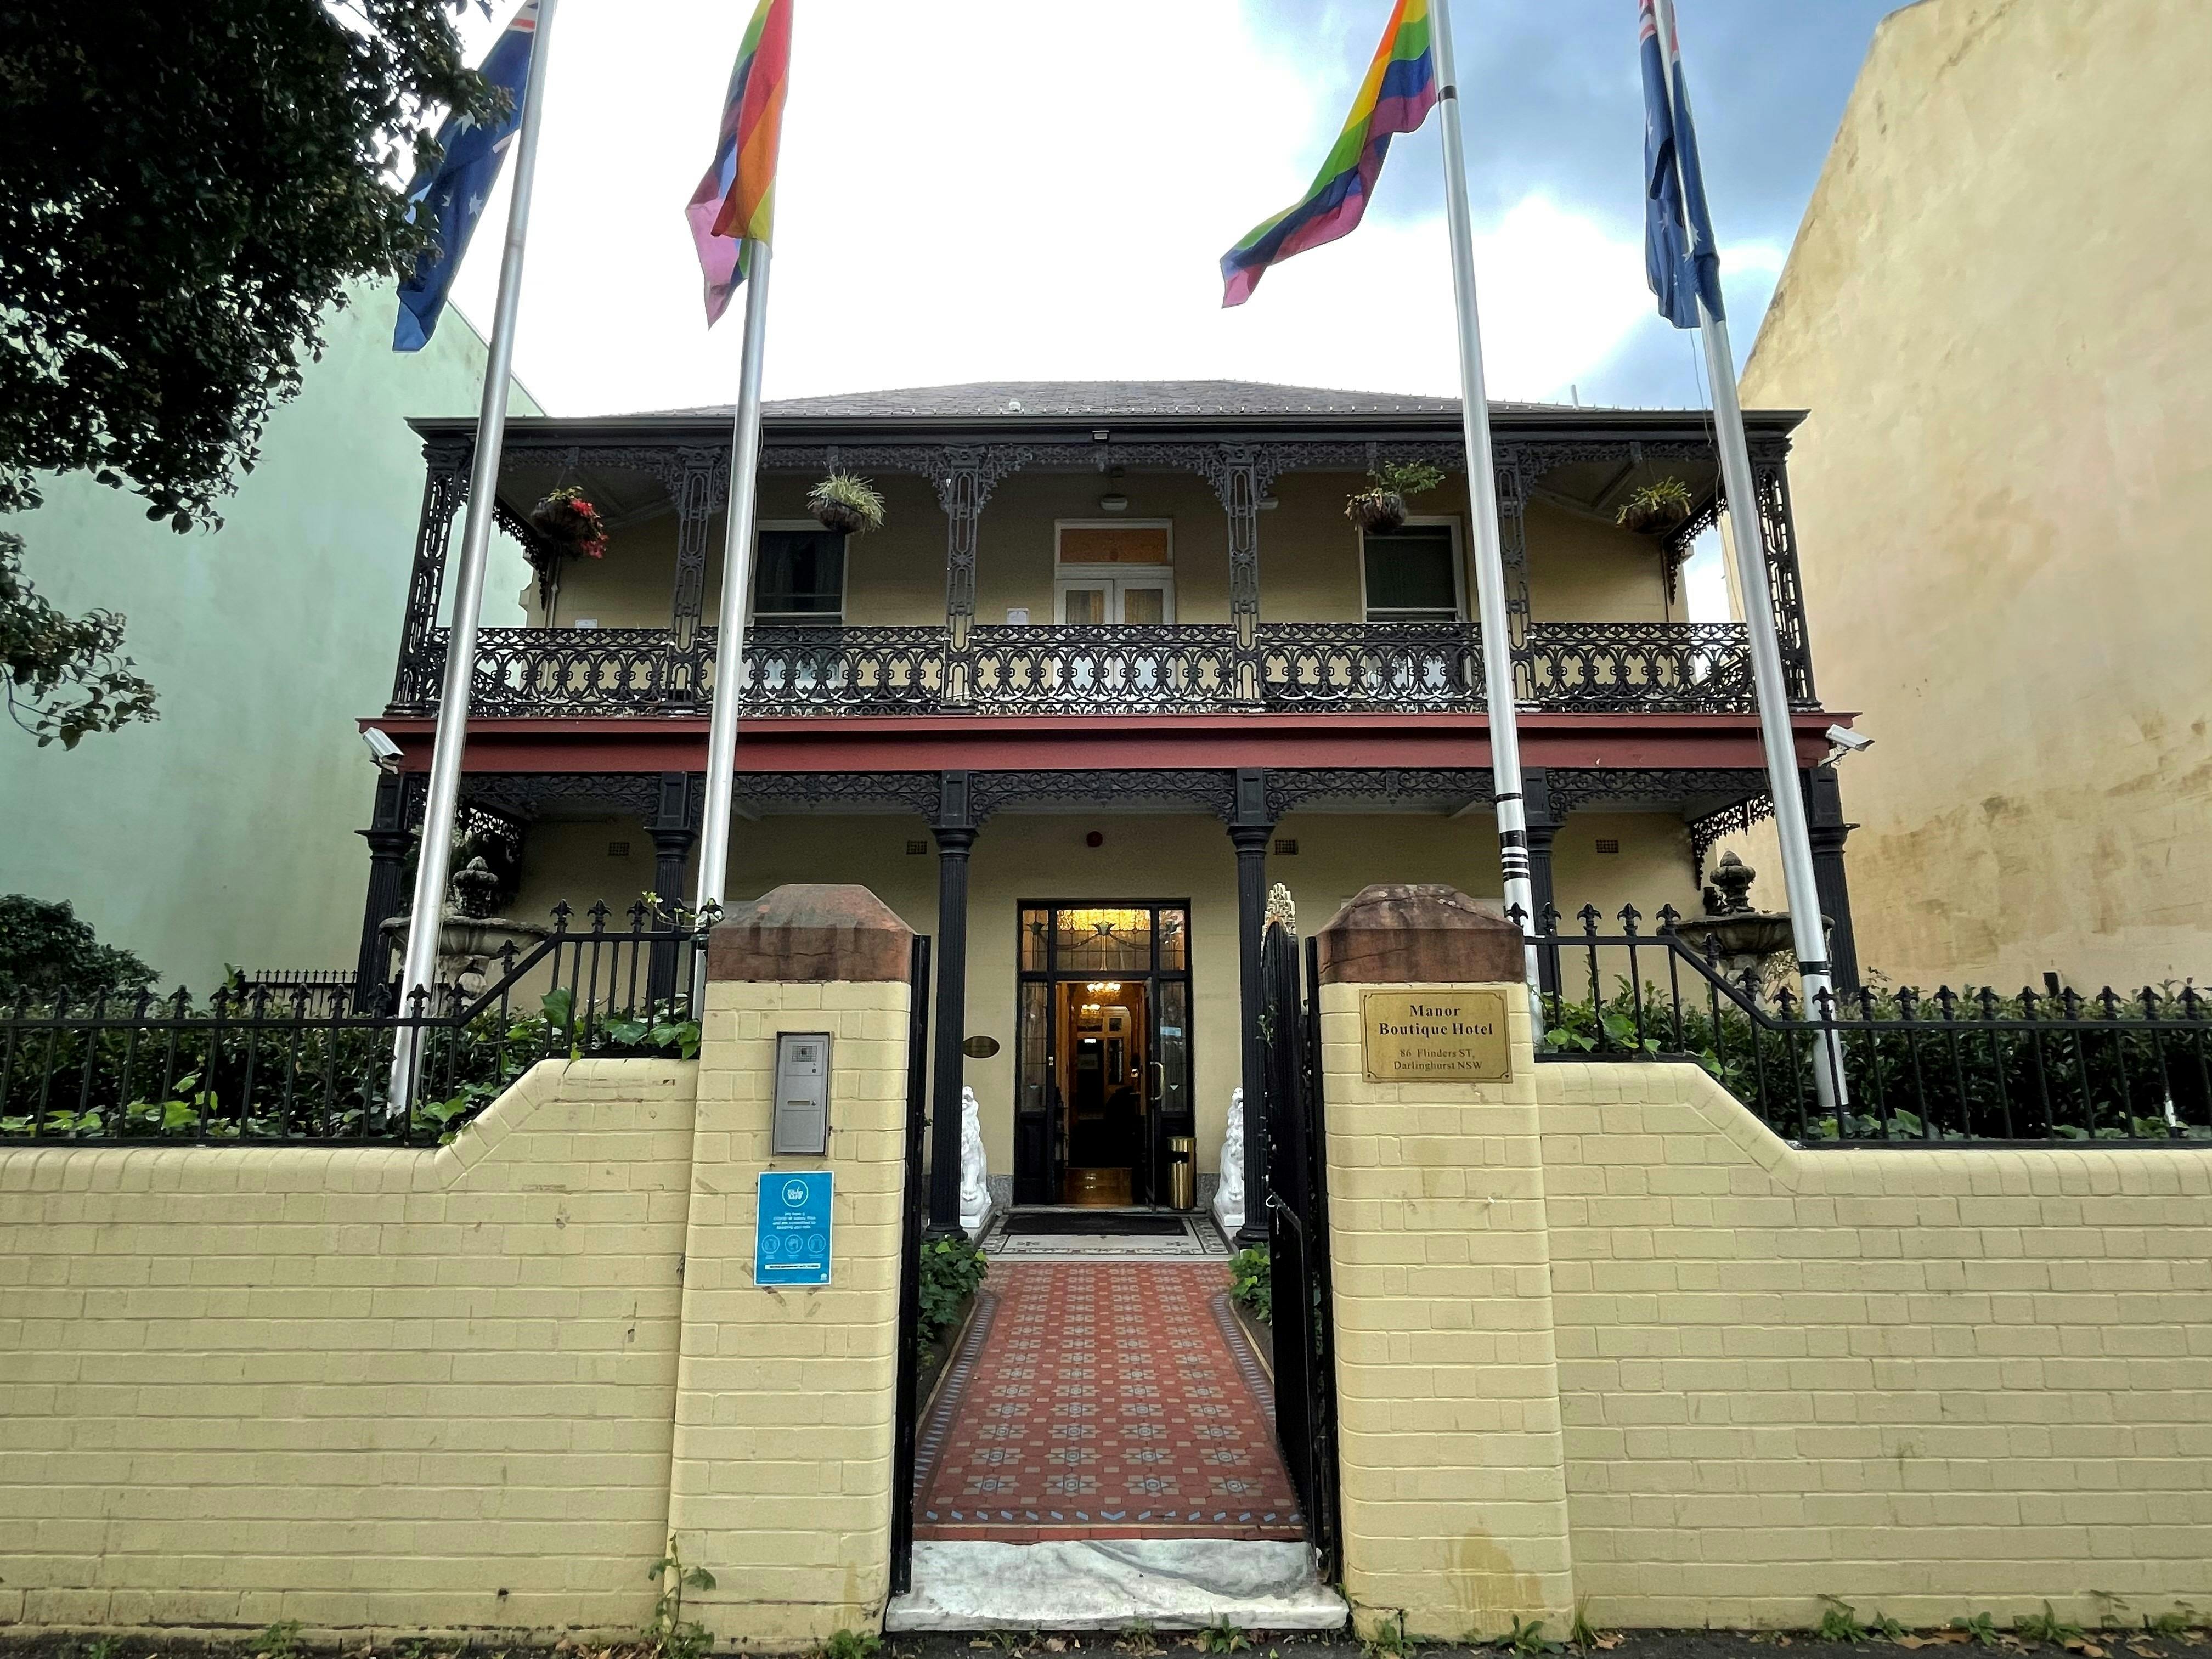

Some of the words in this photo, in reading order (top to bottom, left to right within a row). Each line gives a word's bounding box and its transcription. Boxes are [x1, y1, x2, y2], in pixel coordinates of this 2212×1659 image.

[1410, 1005, 1461, 1017] Manor
[1379, 1023, 1448, 1038] Boutique
[1453, 1023, 1493, 1035] Hotel
[1400, 1049, 1412, 1058] 86
[1417, 1048, 1456, 1058] Flinders
[1394, 1061, 1455, 1071] Darlinghurst
[1458, 1061, 1483, 1070] NSW
